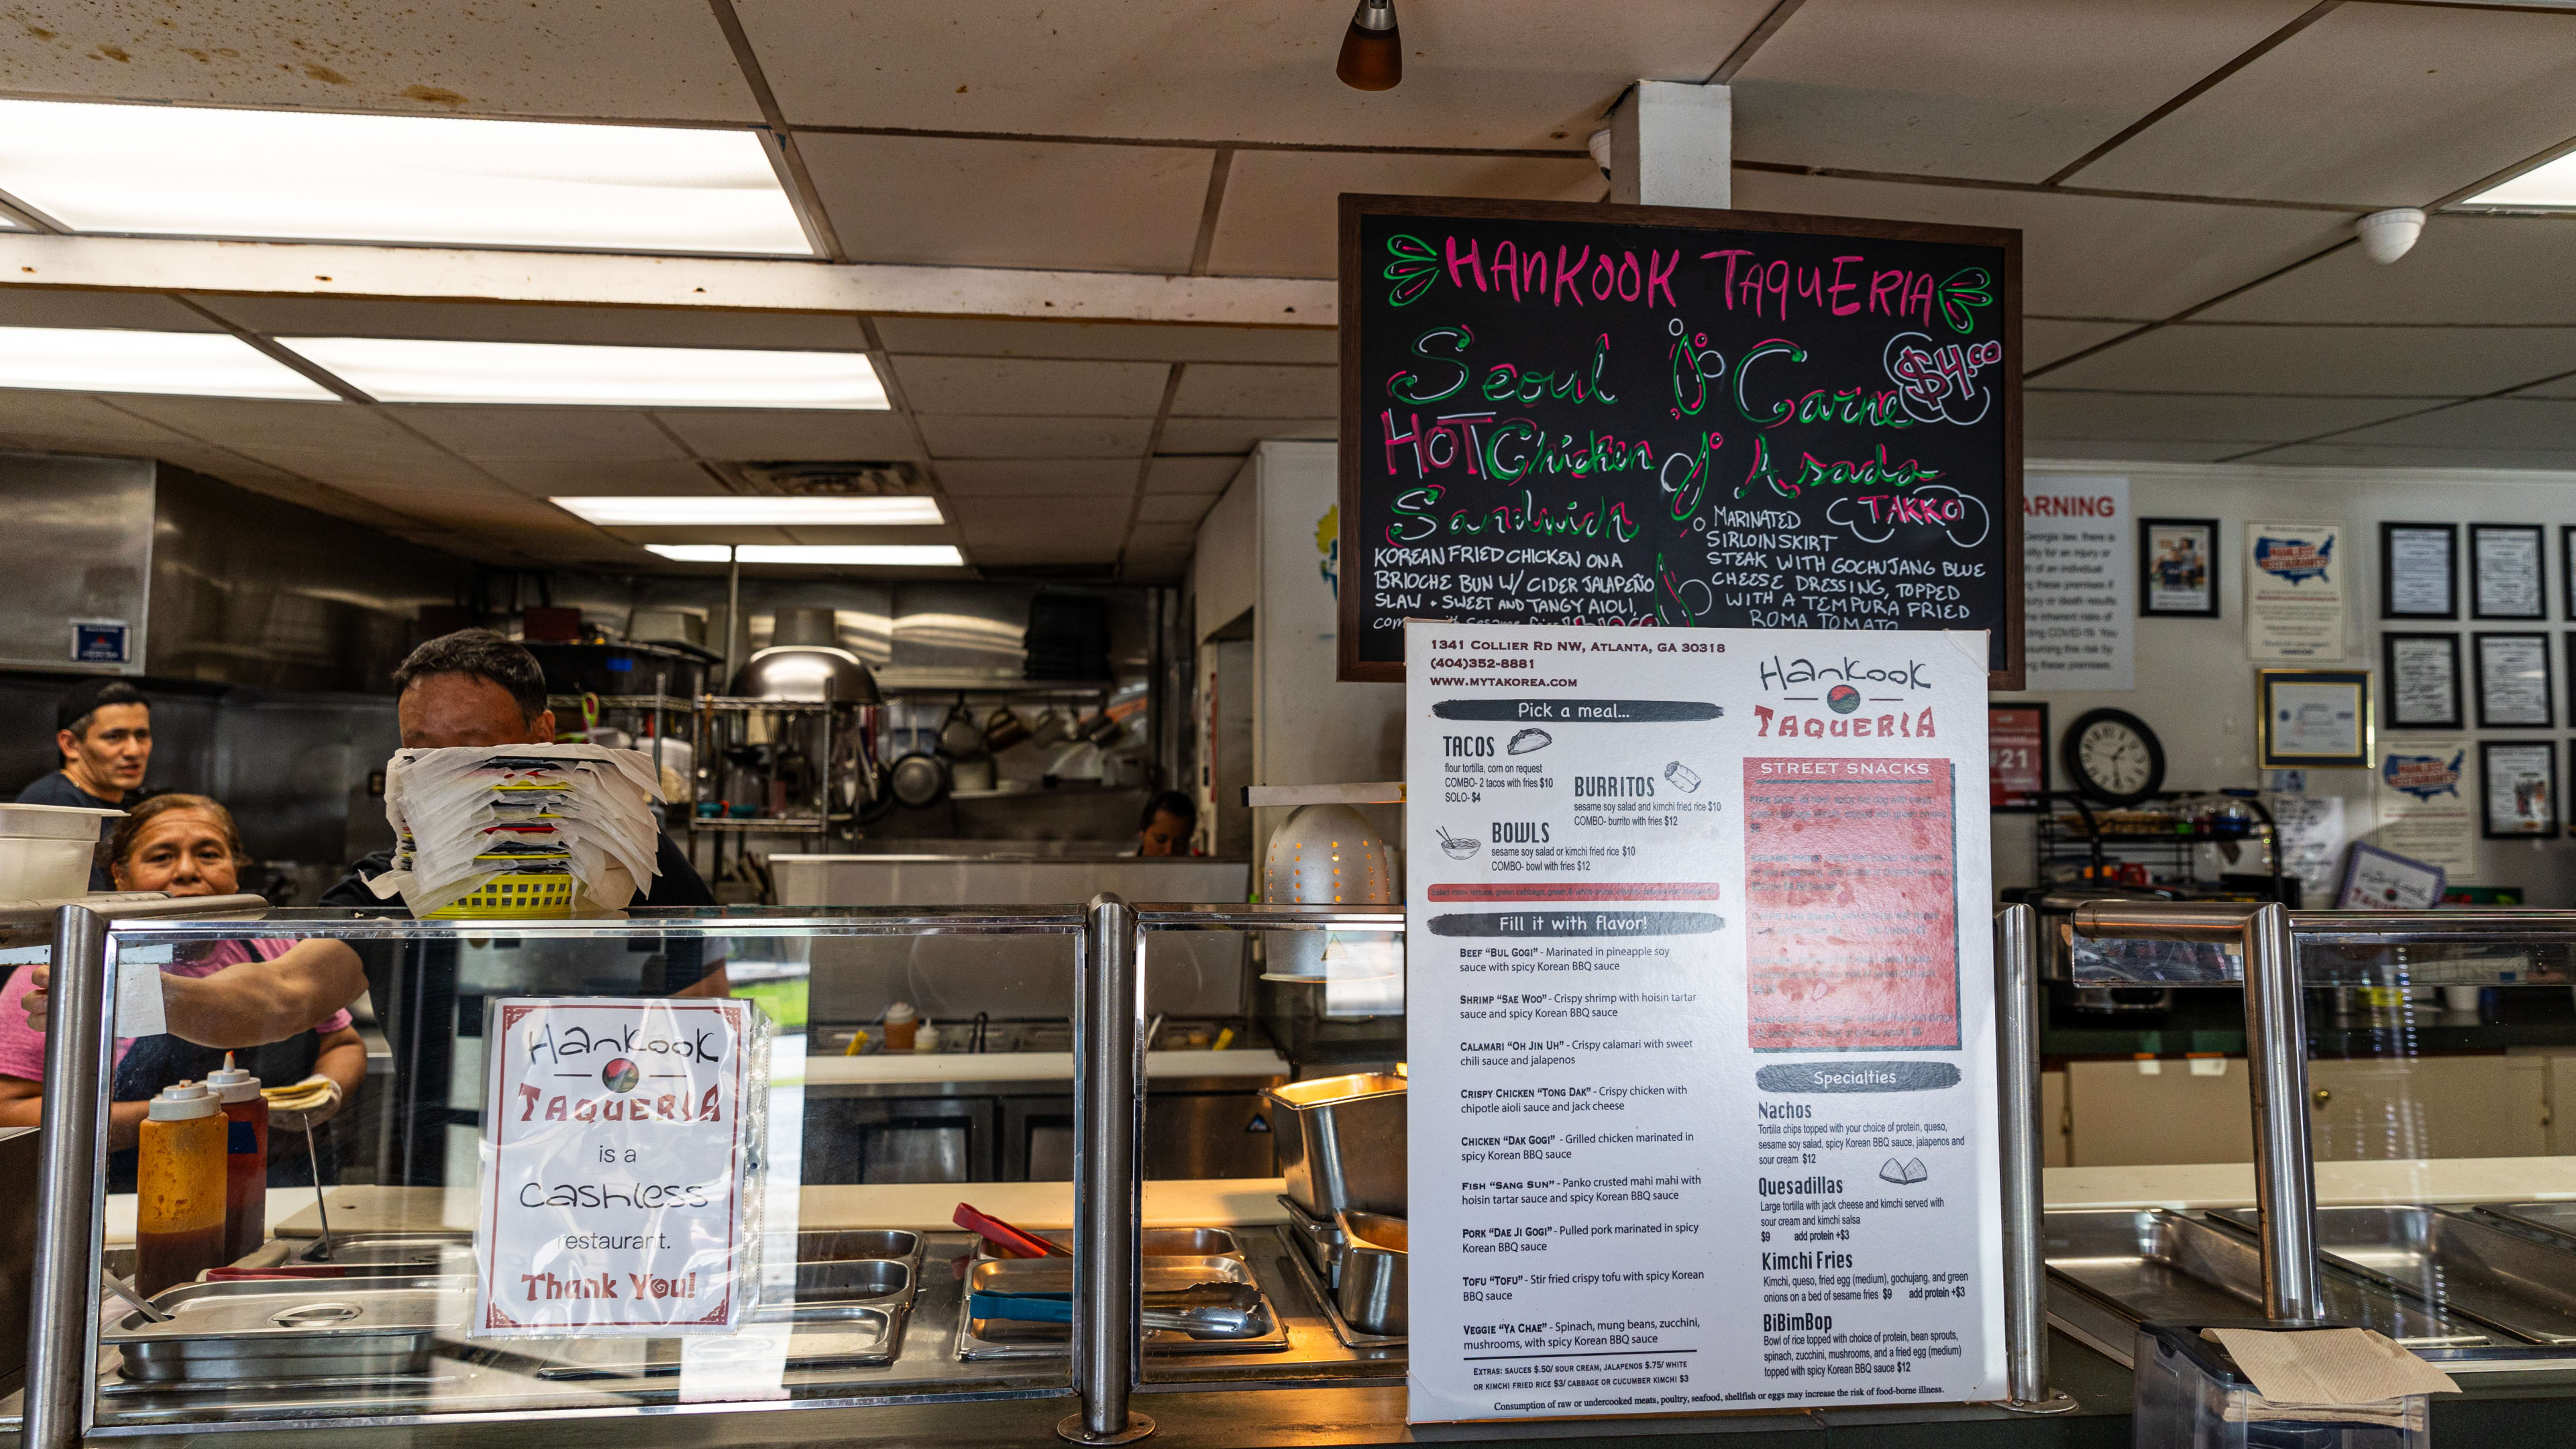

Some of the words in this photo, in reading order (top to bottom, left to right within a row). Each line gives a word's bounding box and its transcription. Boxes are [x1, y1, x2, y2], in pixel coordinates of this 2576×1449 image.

[1387, 325, 1618, 407] Seoul
[1734, 338, 1915, 428] Carne
[1486, 417, 1656, 486] Chicken
[1386, 484, 1640, 547] Sandwich
[1713, 505, 1801, 529] MARINATED
[1857, 494, 1966, 526] TAKKO
[2023, 495, 2116, 518] ARNING
[1706, 531, 1776, 549] SIRLOIN
[1778, 535, 1838, 551] SKIRT
[1374, 547, 1446, 568] KOREAN
[1448, 545, 1505, 564] FRIED
[1505, 547, 1581, 568] CHICKEN
[1706, 551, 1768, 569] STEAK
[1776, 555, 1826, 573] WITH
[1831, 557, 1936, 578] GOCHUJANG
[1941, 561, 1986, 578] BLUE
[1374, 570, 1453, 590] BRIOCHE
[1458, 574, 1494, 593] BUN
[1526, 576, 1578, 594] CIDER
[1711, 572, 1784, 590] CHEESE
[1896, 583, 1961, 601] TOPPED
[1374, 593, 1422, 610] SLAW
[1441, 596, 1495, 612] SWEET
[1497, 598, 1525, 612] AND
[1525, 598, 1585, 614] TANGY
[1725, 591, 1774, 607] WITH
[1781, 592, 1796, 607] A
[1801, 594, 1900, 616] TEMPURA
[1907, 602, 1971, 620] FRIED
[1749, 609, 1809, 629] ROMA
[1432, 639, 1464, 650] 1341
[1557, 641, 1586, 653] NW,
[1657, 643, 1678, 653] GA
[1681, 643, 1726, 653] 30318
[1430, 657, 1534, 670] (404)352-8881
[1760, 655, 1932, 692] Hankook
[1518, 702, 1553, 718] Pick
[1560, 706, 1570, 718] a
[1754, 704, 1937, 739] TAQUERIA
[1442, 735, 1495, 757] TACOS
[1444, 762, 1461, 773] flour
[1462, 763, 1486, 774] tortilla,
[1487, 765, 1503, 773] corn
[1505, 765, 1514, 773] on
[1515, 763, 1543, 775] request
[1760, 762, 1840, 775] STREET
[1847, 763, 1929, 777] SNACKS
[1574, 776, 1655, 798] BURRITOS
[1574, 815, 1607, 826] COMBO-
[1608, 816, 1631, 826] burrito
[1631, 816, 1646, 826] with
[1648, 815, 1663, 826] fries
[1664, 815, 1678, 827] $12
[1492, 822, 1550, 843] BOWLS
[1499, 916, 1524, 931] Fill
[1532, 916, 1544, 930] it
[1551, 915, 1587, 930] with
[1595, 915, 1647, 930] flavor!
[1460, 964, 1487, 972] sauce
[1488, 961, 1509, 971] with
[1511, 961, 1536, 974] spicy
[1537, 961, 1570, 971] Korean
[1572, 961, 1592, 972] BBQ
[1594, 963, 1620, 971] sauce
[527, 1023, 719, 1065] Hankook
[1460, 1055, 1480, 1066] chili
[1482, 1058, 1509, 1066] sauce
[1510, 1055, 1529, 1065] and
[1529, 1055, 1576, 1067] jalapenos
[1814, 1070, 1897, 1089] Specialties
[518, 1082, 722, 1124] TAQUERIA
[1758, 1101, 1812, 1120] Nachos
[598, 1144, 616, 1164] is
[623, 1147, 637, 1164] a
[519, 1181, 710, 1210] Cashless
[1758, 1176, 1843, 1197] Quesadillas
[1760, 1218, 1777, 1227] sour
[1778, 1218, 1801, 1226] cream
[1802, 1215, 1816, 1226] and
[1817, 1214, 1840, 1226] kimchi
[1841, 1214, 1861, 1225] salsa
[1760, 1230, 1771, 1244] $9
[1794, 1230, 1808, 1242] add
[1809, 1230, 1834, 1244] protein
[1835, 1228, 1850, 1242] +$3
[1762, 1251, 1813, 1271] Kimchi
[1816, 1250, 1853, 1269] Fries
[521, 1272, 619, 1302] Thank
[628, 1272, 698, 1301] You!
[1763, 1312, 1833, 1334] BiBimBop
[1764, 1365, 1789, 1379] topped
[1790, 1365, 1806, 1376] with
[1807, 1364, 1826, 1378] spicy
[1827, 1364, 1854, 1375] Korean
[1854, 1362, 1872, 1374] BBQ
[1873, 1364, 1895, 1373] sauce
[1896, 1360, 1911, 1374] $12
